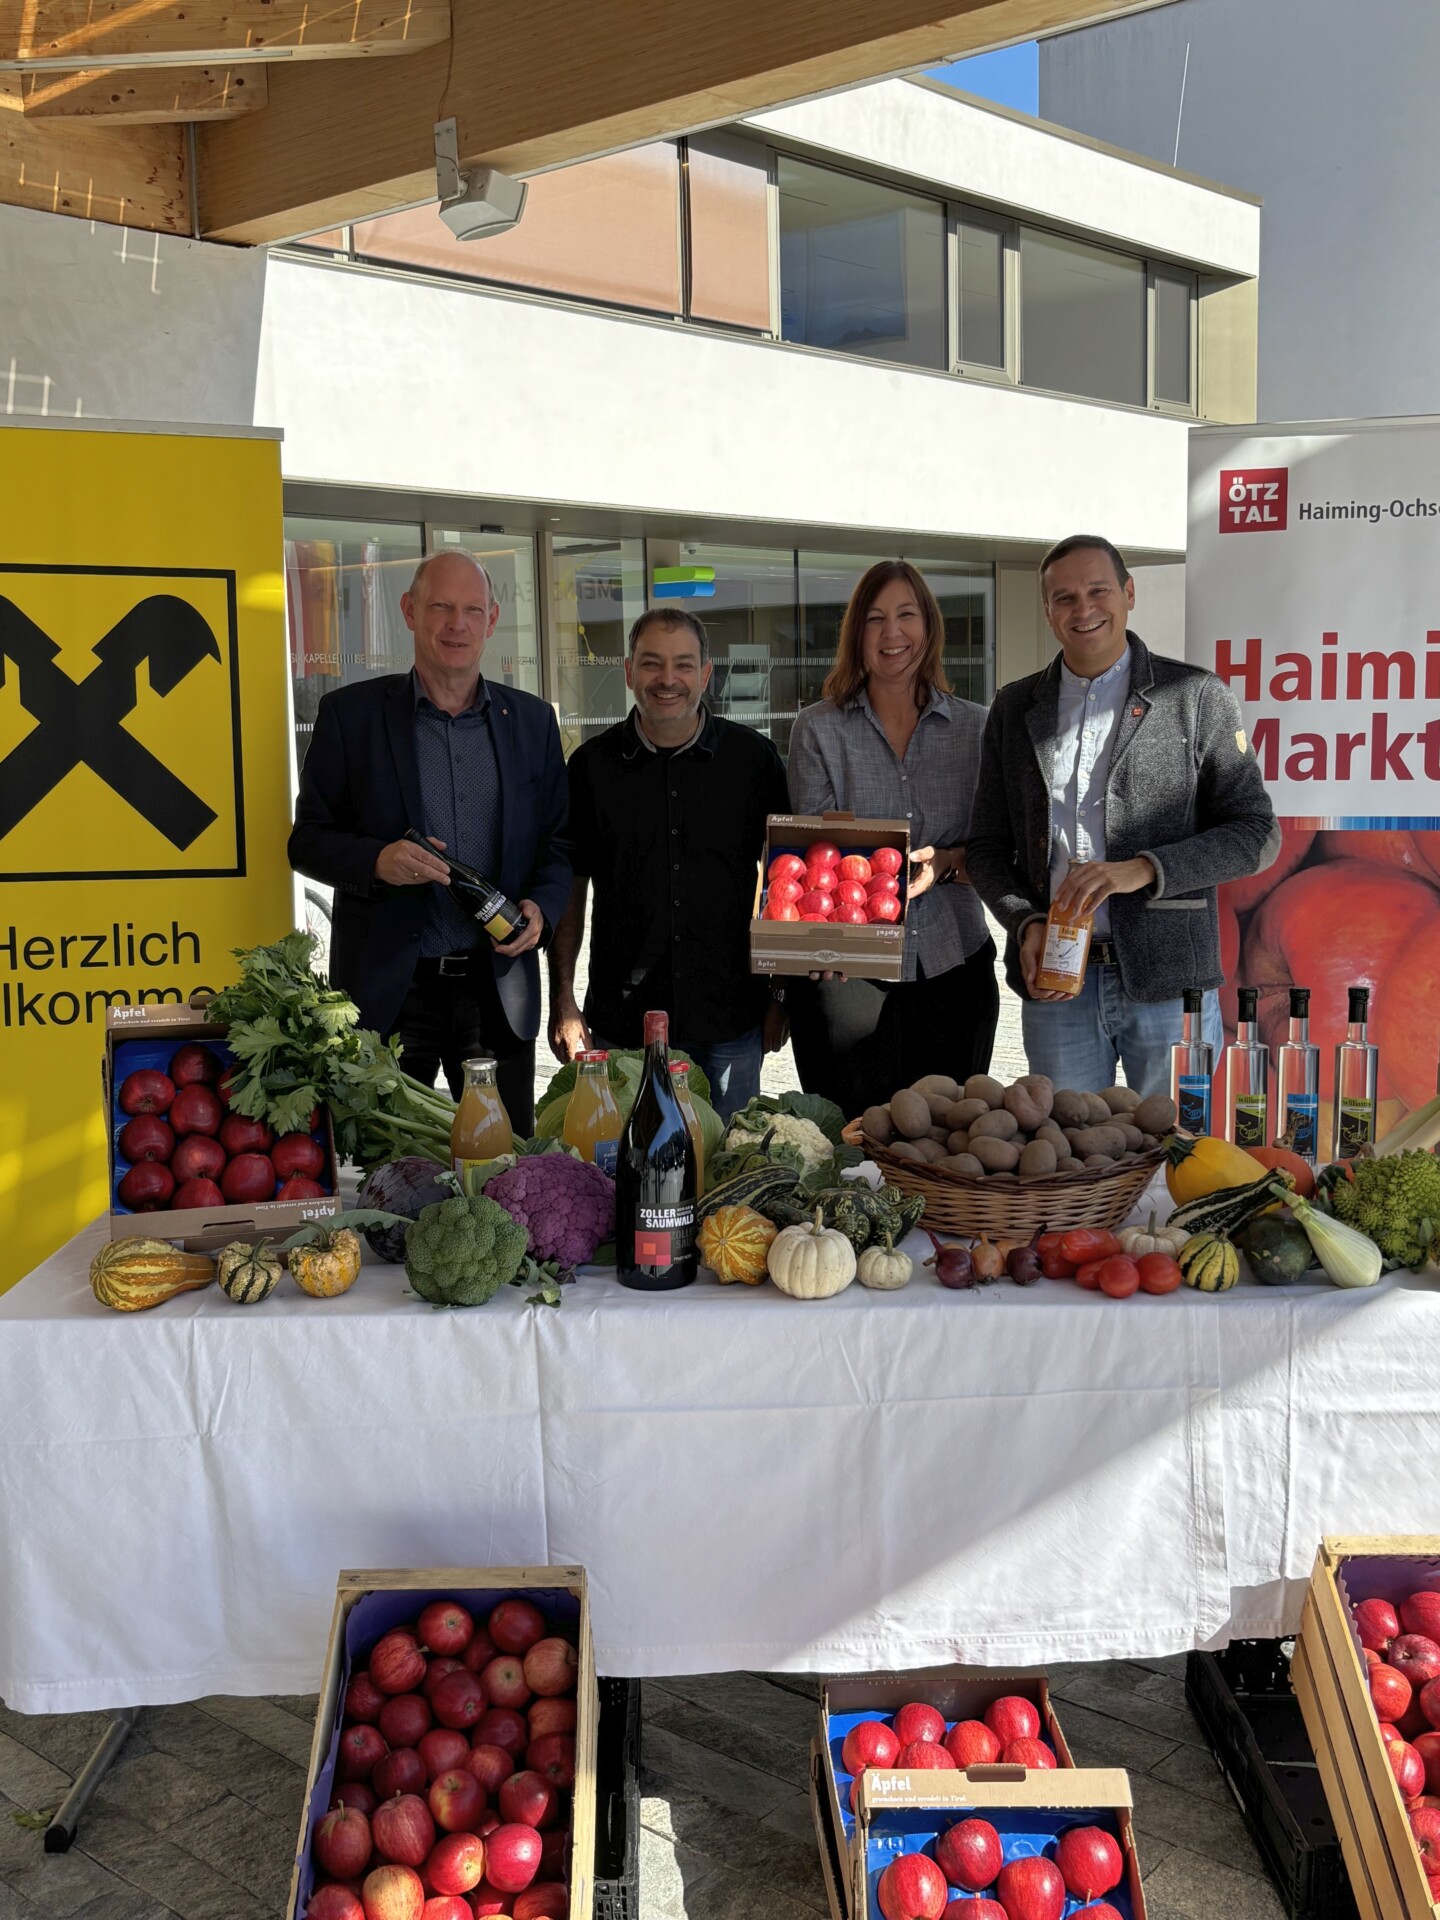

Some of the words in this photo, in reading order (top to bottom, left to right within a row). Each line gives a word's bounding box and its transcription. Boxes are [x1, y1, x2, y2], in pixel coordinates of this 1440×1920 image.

[1228, 477, 1279, 502] ÖTZ
[1229, 505, 1278, 524] TAL
[1298, 498, 1440, 523] Haiming-Ochs
[1215, 630, 1440, 702] Haimi
[474, 900, 494, 920] ZOLLER
[1061, 927, 1075, 935] bio
[112, 1007, 146, 1020] Äpfel
[639, 1208, 676, 1219] ZOLLER
[645, 1214, 694, 1228] SAUMWALD
[871, 1773, 912, 1795] Äpfel
